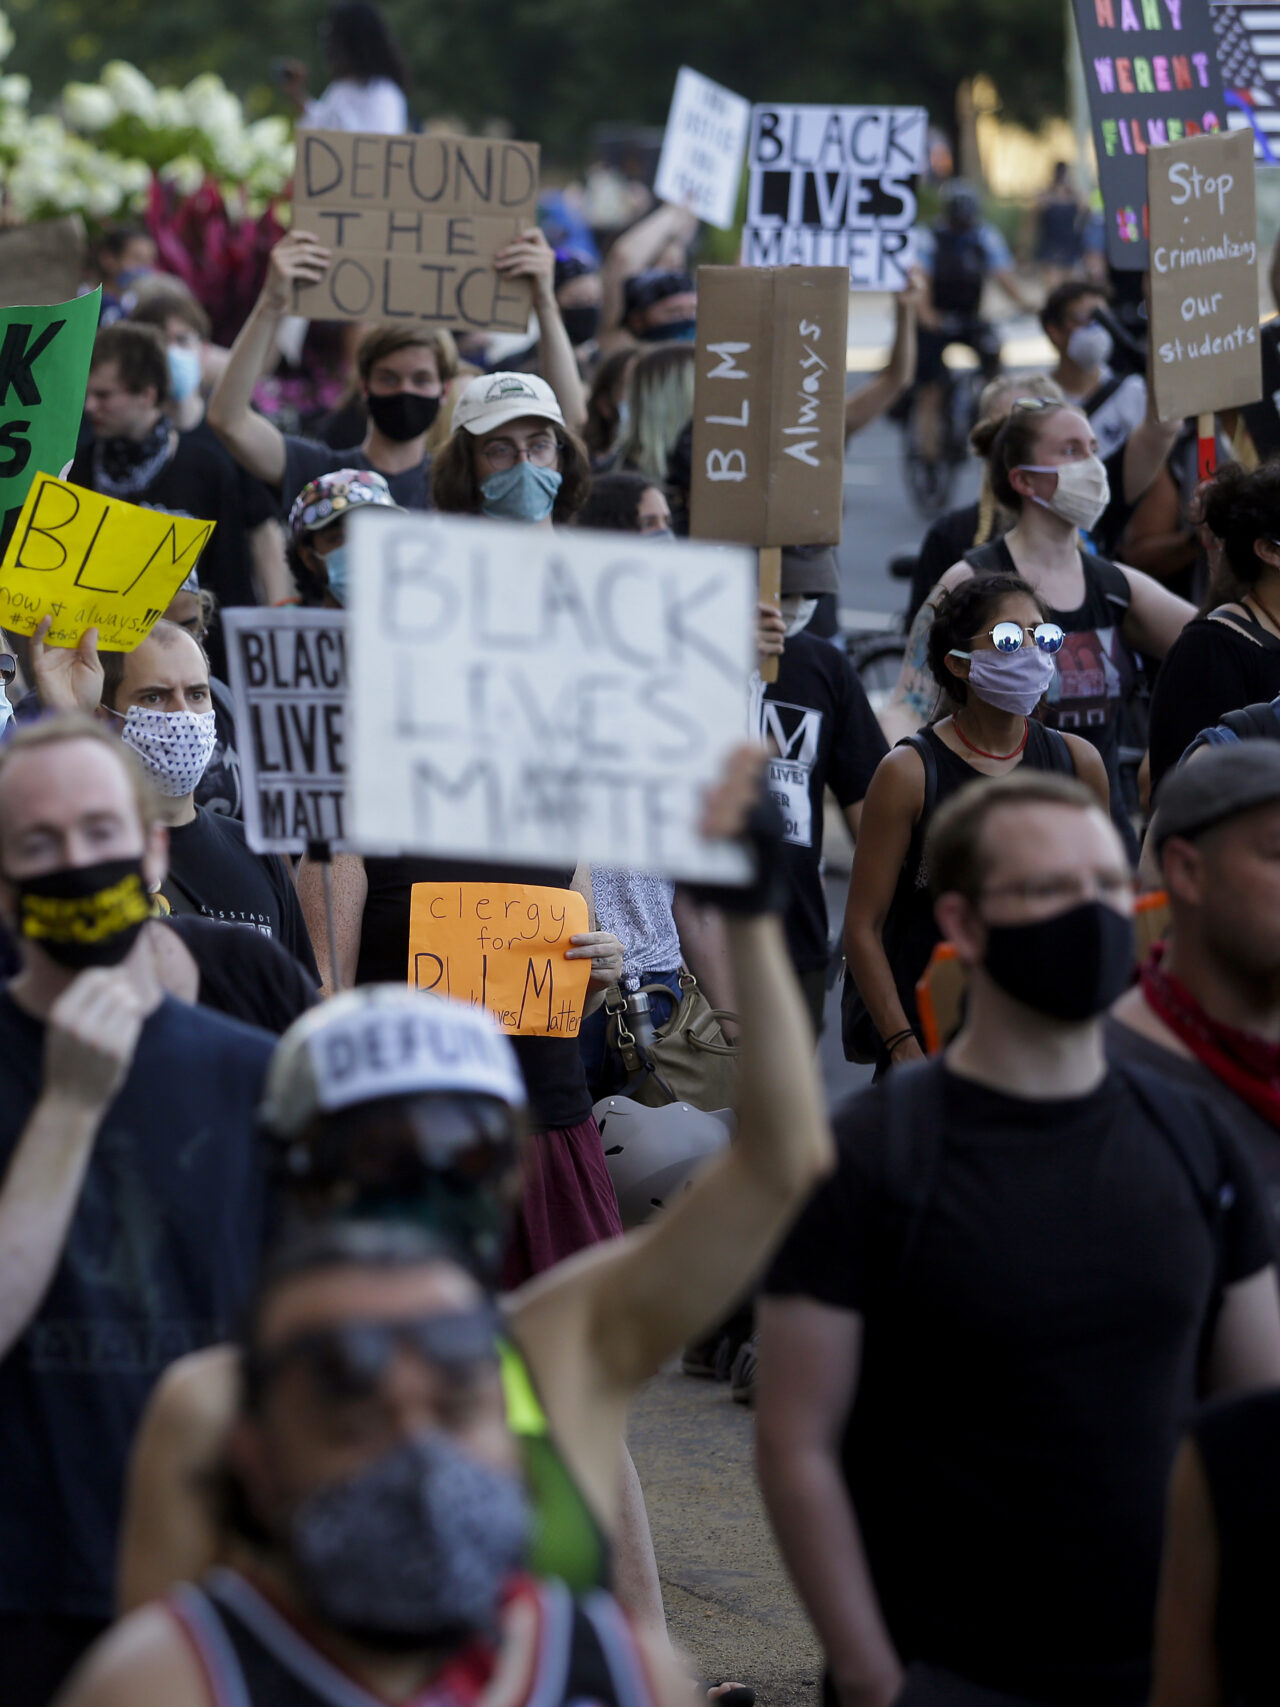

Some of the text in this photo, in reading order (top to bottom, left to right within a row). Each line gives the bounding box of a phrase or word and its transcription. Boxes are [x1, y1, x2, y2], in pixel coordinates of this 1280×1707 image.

[1093, 52, 1209, 94] WERENT
[756, 112, 926, 166] BLACK
[304, 135, 537, 207] DEFUND
[747, 170, 918, 229] LIVES
[1167, 162, 1234, 215] Stop
[318, 211, 476, 256] THE
[748, 228, 909, 284] MATTER
[781, 318, 828, 467] Always
[14, 480, 211, 597] BLM
[377, 526, 746, 685] BLACK
[393, 650, 707, 762] LIVES
[250, 703, 344, 774] LIVE
[261, 788, 344, 840] MATT
[412, 755, 695, 867] MATTE
[430, 887, 566, 943] clergy
[477, 926, 521, 950] for
[517, 957, 582, 1033] Matter
